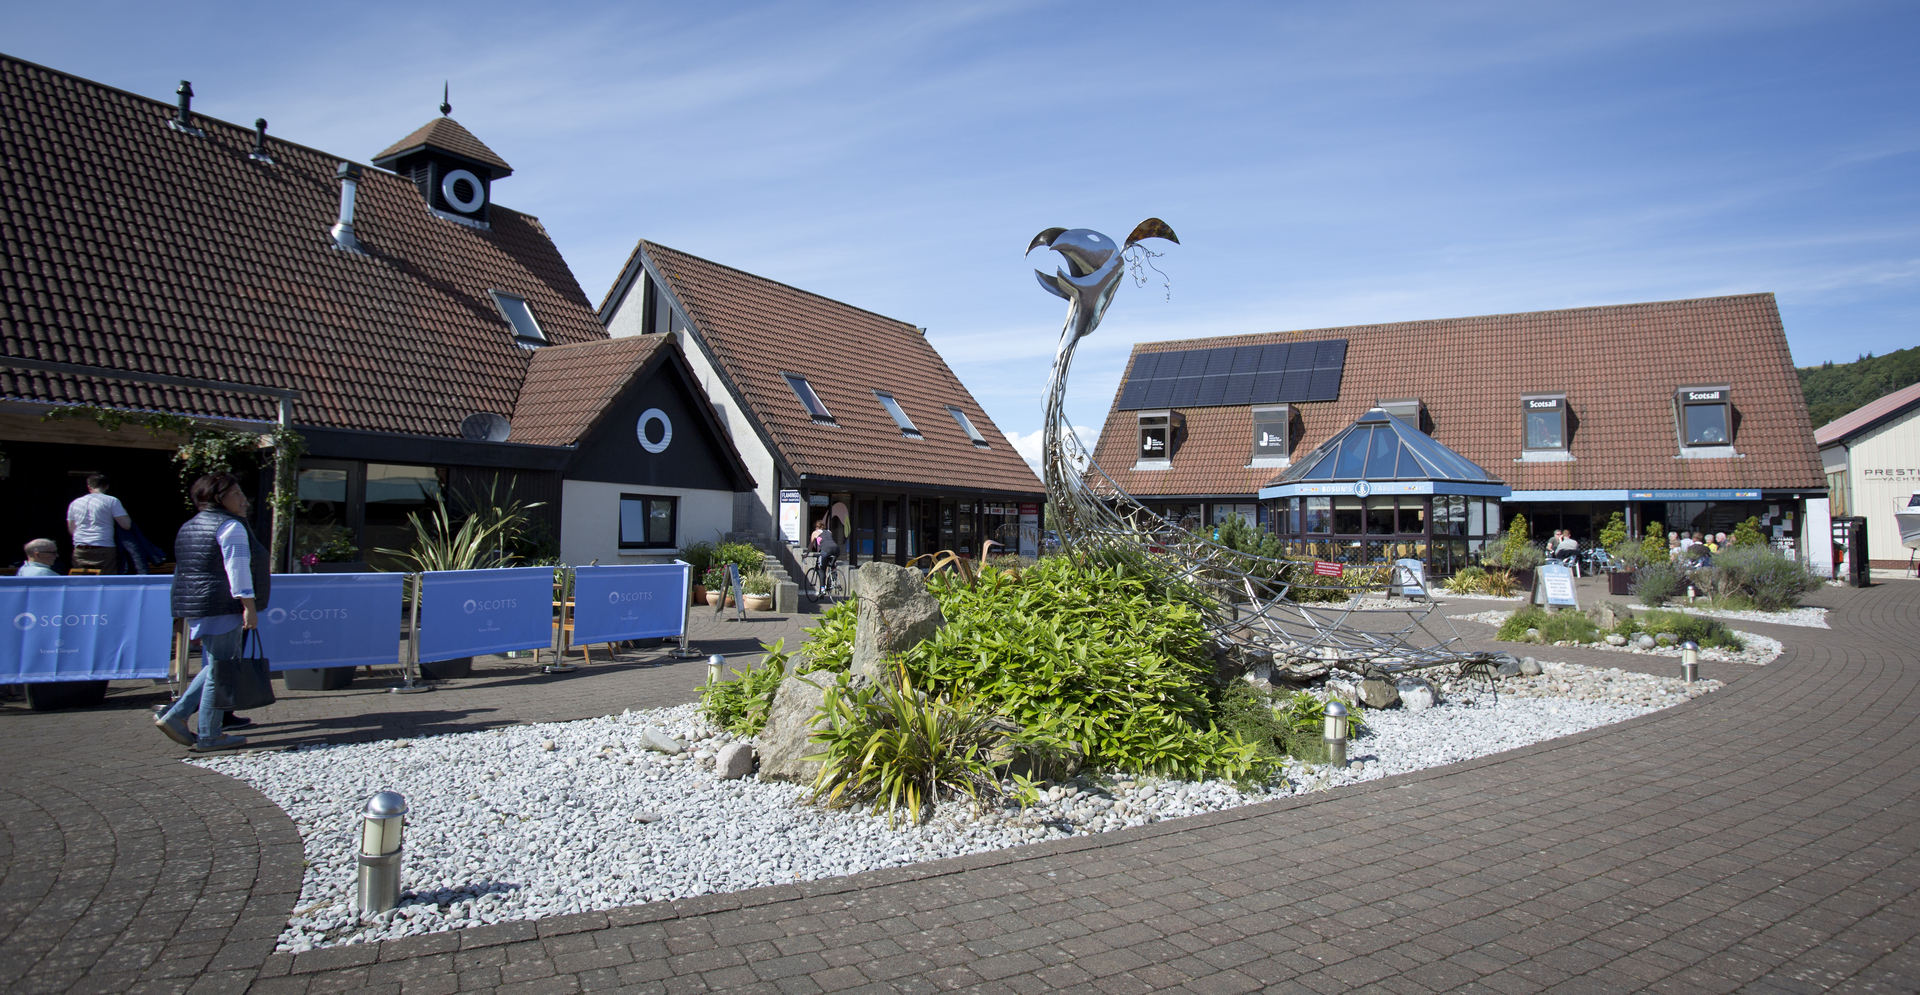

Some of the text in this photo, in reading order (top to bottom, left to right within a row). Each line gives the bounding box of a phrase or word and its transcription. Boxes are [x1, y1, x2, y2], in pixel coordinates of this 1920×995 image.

[1689, 391, 1720, 400] Scotsail
[1529, 400, 1557, 408] Scotsail
[1321, 484, 1396, 493] BOSUN'S TABLE
[620, 591, 653, 602] SCOTTS
[477, 598, 517, 611] SCOTTS
[40, 613, 108, 627] SCOTTS
[289, 608, 348, 621] SCOTTS
